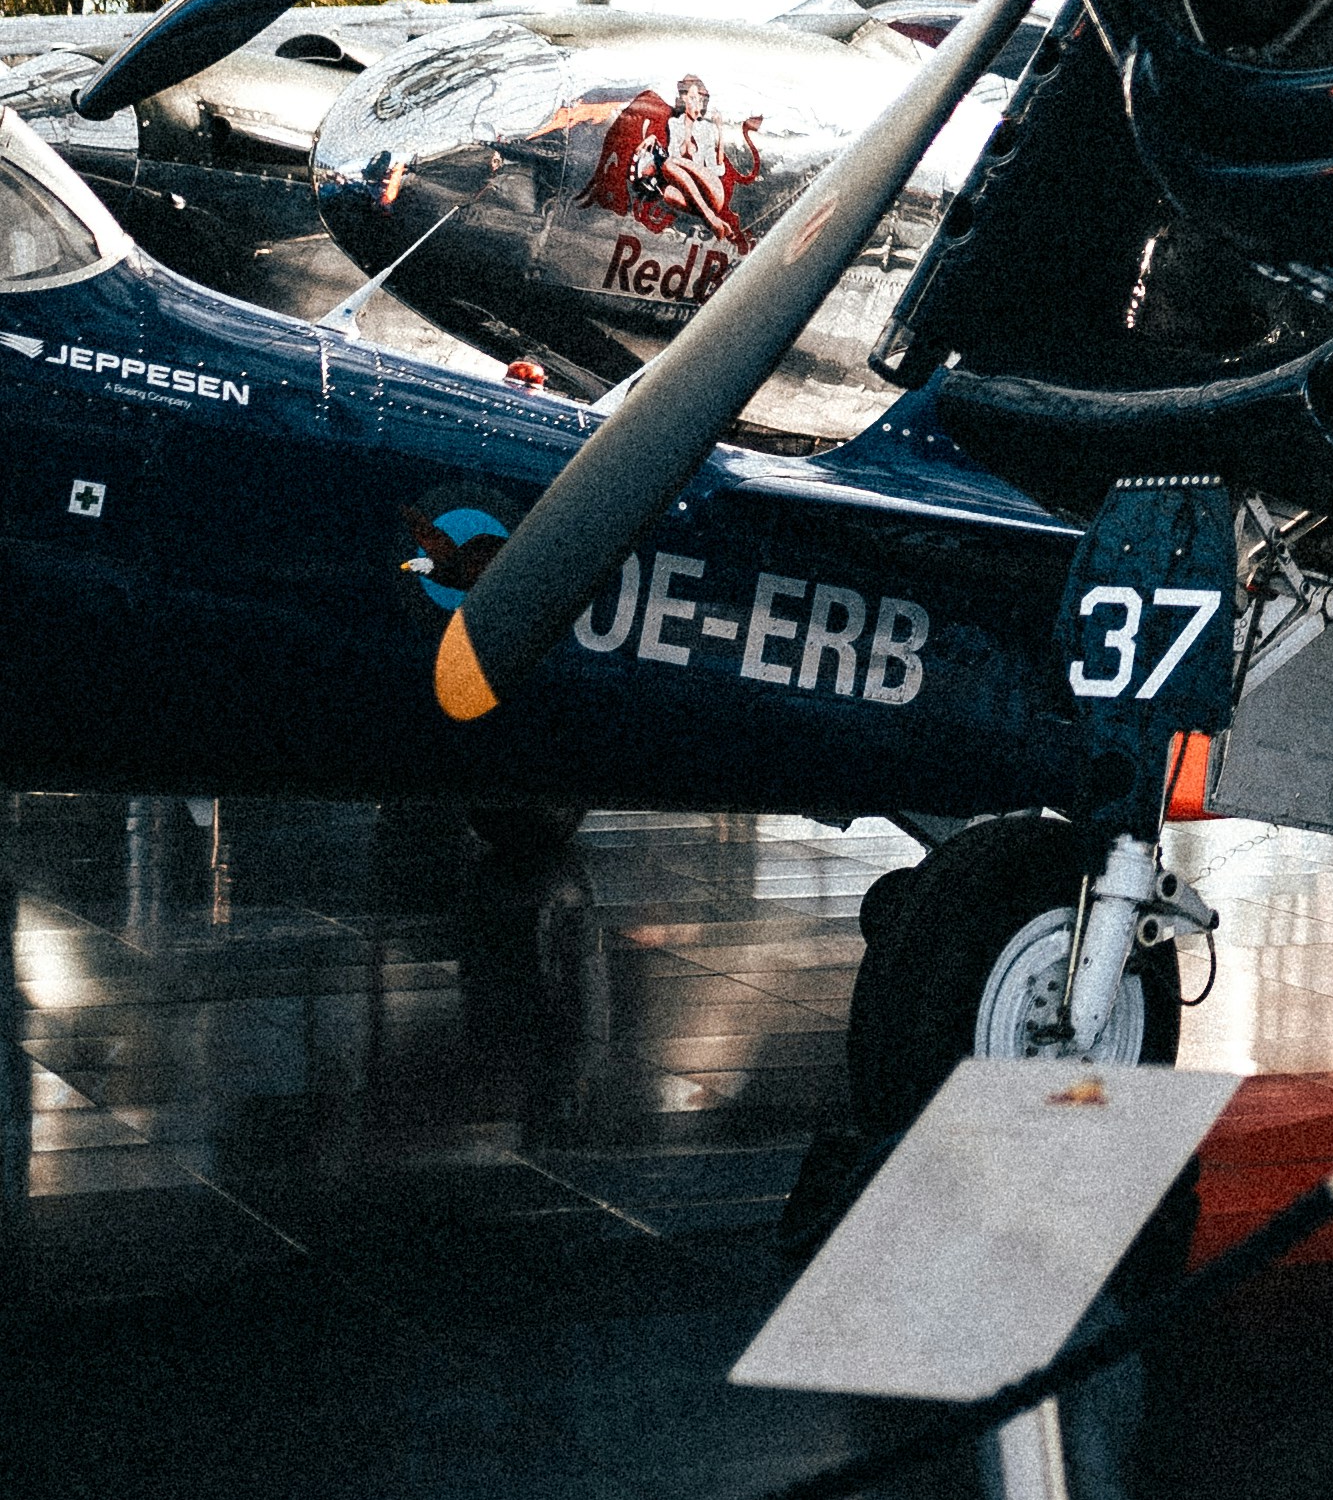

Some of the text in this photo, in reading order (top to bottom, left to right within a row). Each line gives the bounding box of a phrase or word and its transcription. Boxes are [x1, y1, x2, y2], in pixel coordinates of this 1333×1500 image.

[602, 233, 699, 302] Red
[45, 345, 249, 406] JEPPESEN
[113, 384, 146, 400] Boeing
[148, 391, 192, 409] Company
[1068, 586, 1222, 699] 37
